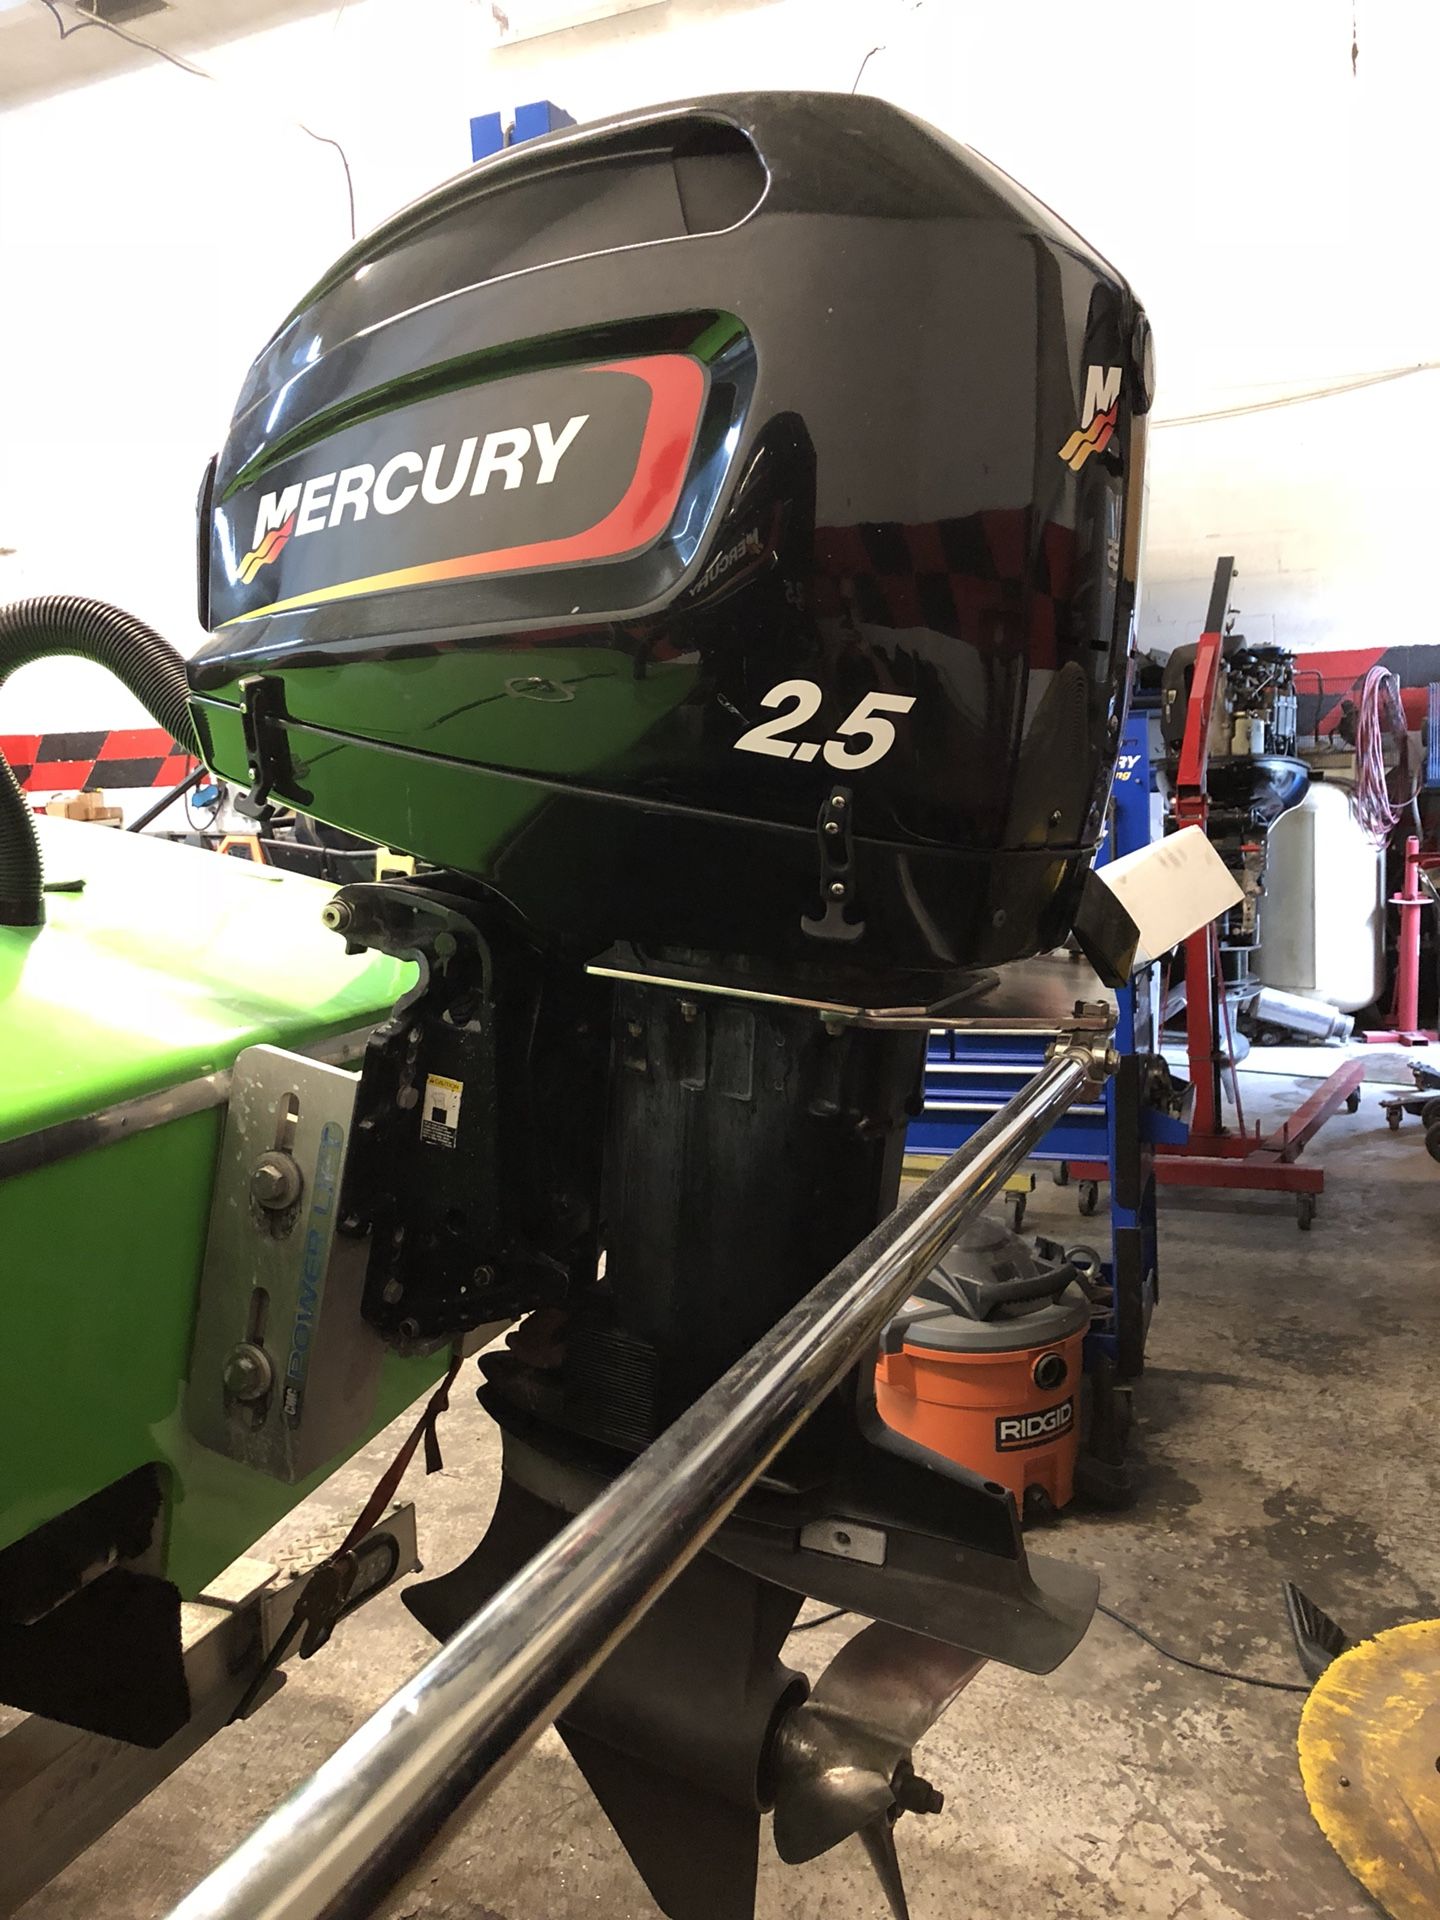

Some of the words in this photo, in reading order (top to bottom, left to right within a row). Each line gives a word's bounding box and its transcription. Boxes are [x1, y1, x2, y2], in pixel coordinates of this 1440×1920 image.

[253, 414, 590, 551] MERCURY
[733, 678, 917, 771] 2.5
[288, 1228, 321, 1381] POWER
[1000, 1403, 1072, 1440] RIDGID
